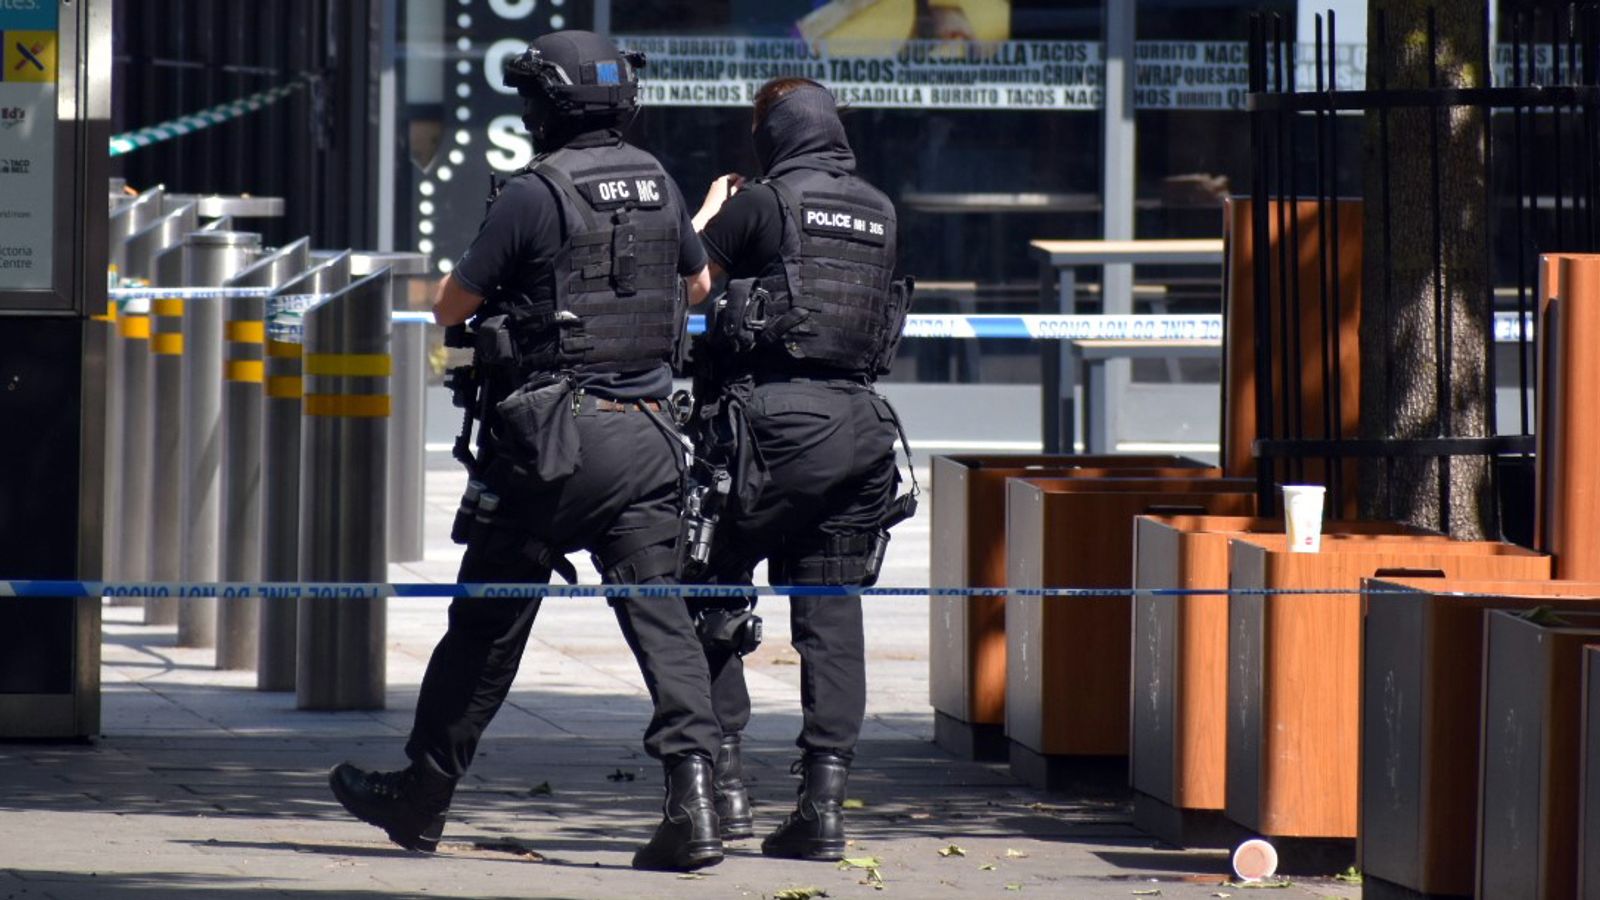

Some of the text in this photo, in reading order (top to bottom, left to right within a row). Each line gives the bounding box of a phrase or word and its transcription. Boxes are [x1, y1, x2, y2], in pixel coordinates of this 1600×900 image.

[668, 39, 737, 56] BURRITO
[744, 41, 820, 60] NACHOS
[1031, 44, 1087, 62] TACOS
[830, 58, 895, 83] TACOS
[978, 68, 1041, 83] BURRITO
[668, 85, 741, 102] NACHOS
[831, 86, 923, 104] UESADILLA
[930, 88, 999, 105] BURRITO
[1006, 89, 1056, 106] TACOS
[598, 179, 661, 203] OFC MC
[807, 210, 852, 228] POLICE
[0, 244, 33, 256] ictoria
